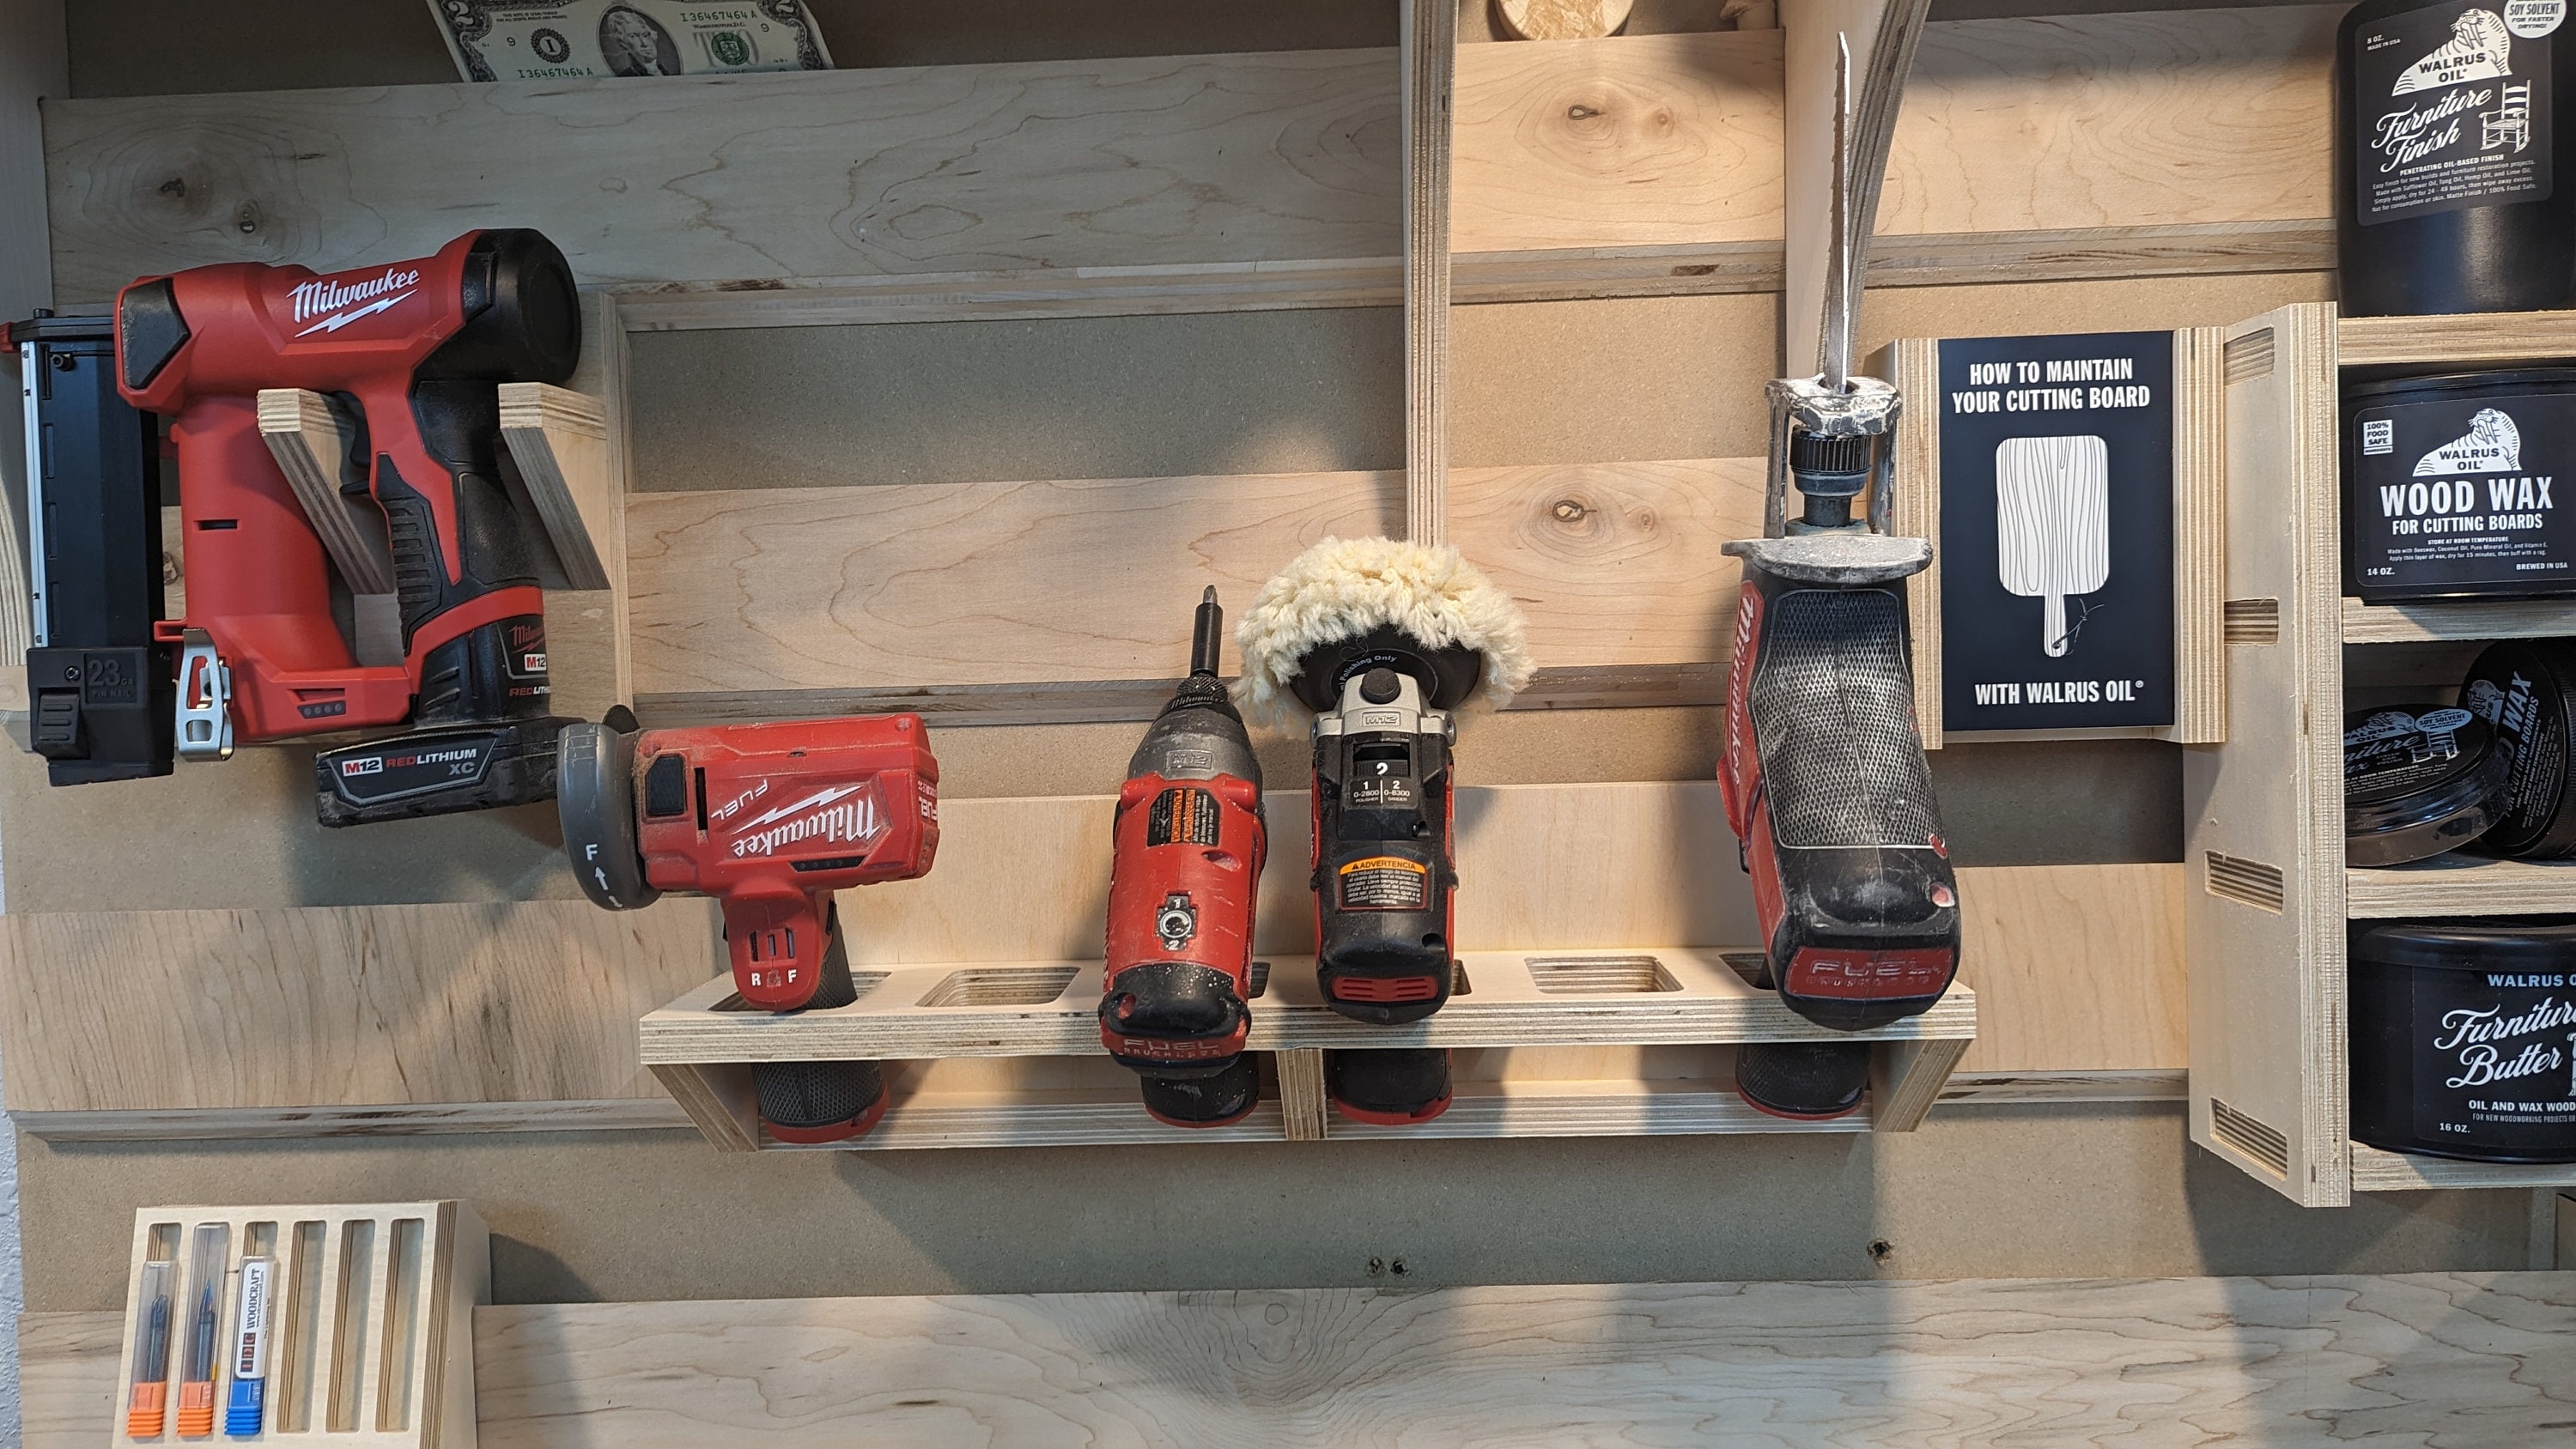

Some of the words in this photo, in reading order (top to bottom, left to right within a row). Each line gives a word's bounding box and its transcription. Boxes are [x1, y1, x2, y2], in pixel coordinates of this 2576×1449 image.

[2509, 3, 2524, 15] SOY
[2526, 3, 2561, 15] SOLVENT
[761, 23, 769, 33] 9
[507, 37, 516, 46] 9
[2419, 52, 2487, 74] WALRUS
[2371, 88, 2493, 149] Furniture
[2380, 117, 2462, 173] Finish
[2400, 162, 2442, 176] PENETRATING
[2444, 157, 2479, 169] OIL-BASED
[2481, 154, 2504, 163] FINISH
[286, 268, 420, 324] Milwaukee
[1970, 362, 2011, 385] HOW
[2016, 361, 2039, 384] TO
[2046, 358, 2133, 382] MAINTAIN
[1952, 391, 2000, 414] YOUR
[2006, 387, 2084, 412] CUTTING
[2089, 385, 2150, 409] BOARD
[2439, 447, 2500, 460] WALRUS
[2379, 481, 2475, 517] WOOD
[2488, 476, 2554, 511] WAX
[2392, 521, 2419, 535] FOR
[2422, 517, 2484, 533] CUTTING
[2488, 513, 2543, 530] BOARDS
[2367, 567, 2378, 576] 14
[2379, 567, 2396, 576] OZ.
[88, 659, 122, 687] 23
[526, 657, 545, 669] M12
[1340, 657, 1372, 682] Polishing
[1374, 655, 1398, 664] Only
[1732, 597, 1754, 785] Milwaukee
[1975, 683, 2020, 705] WITH
[2026, 681, 2099, 704] WALRUS
[2502, 670, 2532, 733] WAX
[1366, 716, 1397, 724] M12
[2434, 714, 2466, 723] SOLVENT
[2510, 744, 2527, 793] CUTTING
[2520, 695, 2539, 745] BOARDS
[345, 760, 380, 774] M12
[386, 749, 477, 768] REDLITHIUM
[448, 761, 475, 775] XC
[1363, 781, 1368, 790] 1
[1393, 780, 1400, 789] 2
[711, 779, 769, 822] FUEL
[731, 796, 880, 858] Milwaukee
[586, 843, 598, 861] F
[1359, 860, 1416, 869] ADVERTENCIA
[1173, 899, 1182, 908] 1
[1168, 940, 1180, 950] 2
[751, 973, 762, 986] R
[788, 969, 797, 983] F
[2488, 974, 2564, 987] WALRUS
[1124, 1039, 1218, 1050] FUEL
[2445, 1042, 2563, 1088] Butter
[2469, 1100, 2488, 1110] OIL
[2491, 1101, 2515, 1112] AND
[2518, 1102, 2543, 1112] WAX
[2472, 1113, 2484, 1121] FOR
[2500, 1114, 2542, 1123] WOODWORKING
[2543, 1114, 2567, 1123] PROJECTS
[2439, 1123, 2451, 1131] 16
[2454, 1124, 2470, 1134] OZ.
[246, 1268, 260, 1329] WOODCRAFT
